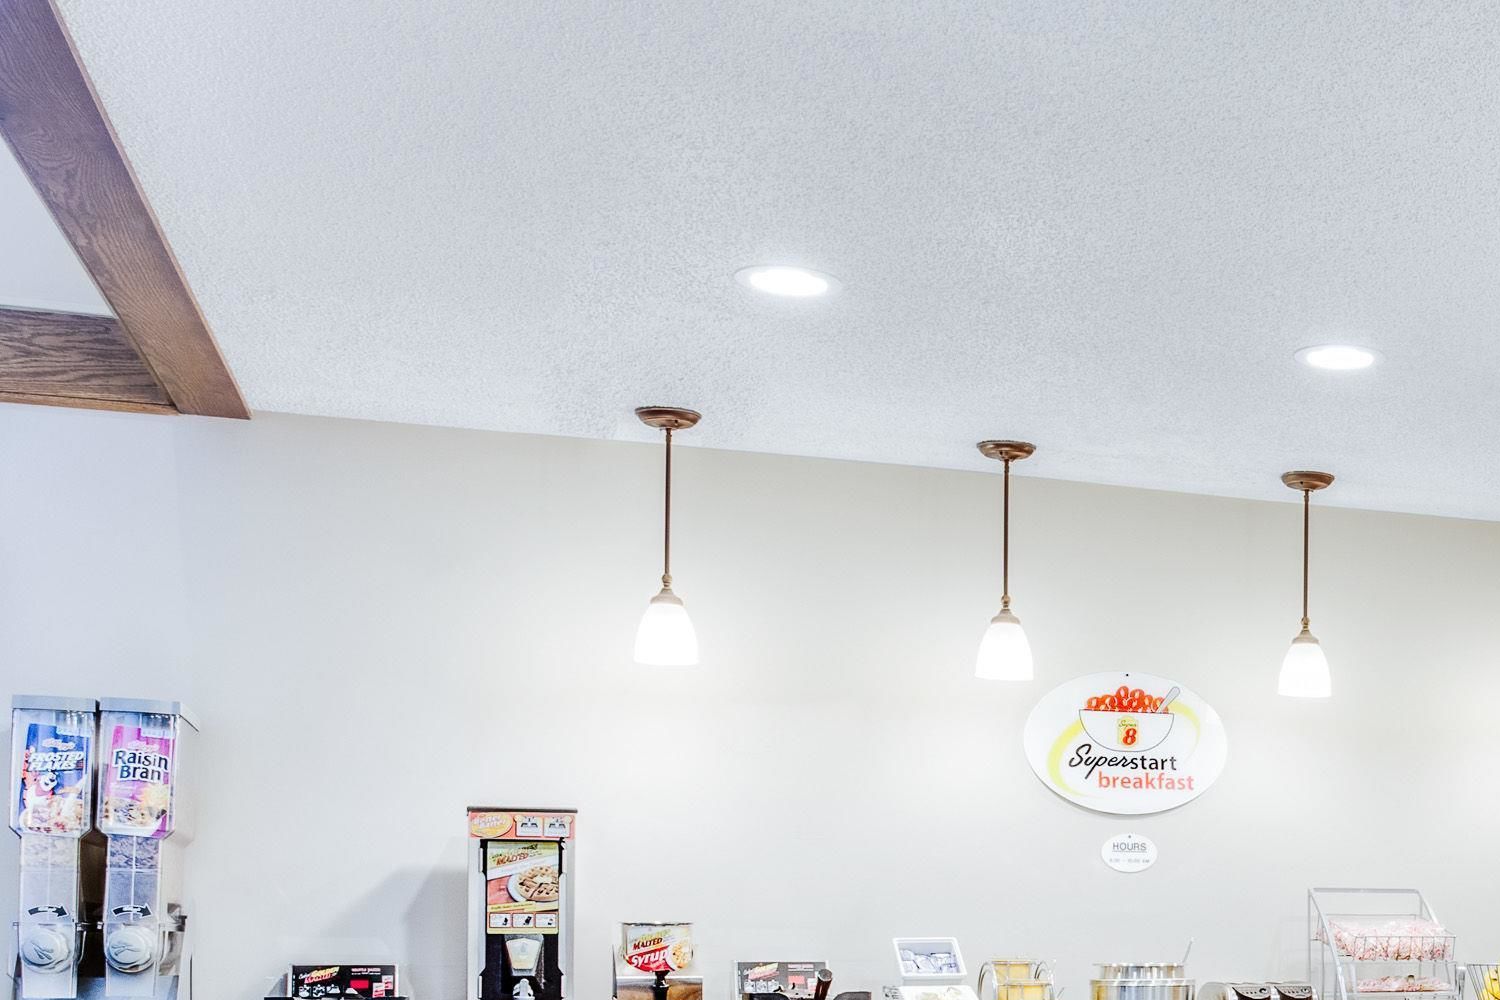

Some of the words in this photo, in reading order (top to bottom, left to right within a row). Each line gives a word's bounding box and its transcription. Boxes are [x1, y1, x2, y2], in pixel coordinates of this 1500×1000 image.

[1122, 728, 1137, 746] 8
[28, 751, 84, 762] FROSTED
[114, 750, 168, 770] Raisin
[1068, 743, 1177, 780] Superstart
[27, 760, 76, 772] FLAKES
[119, 765, 161, 781] Bran
[1098, 771, 1194, 791] breakfast
[1112, 842, 1147, 851] HOURS
[631, 948, 669, 968] Syrup
